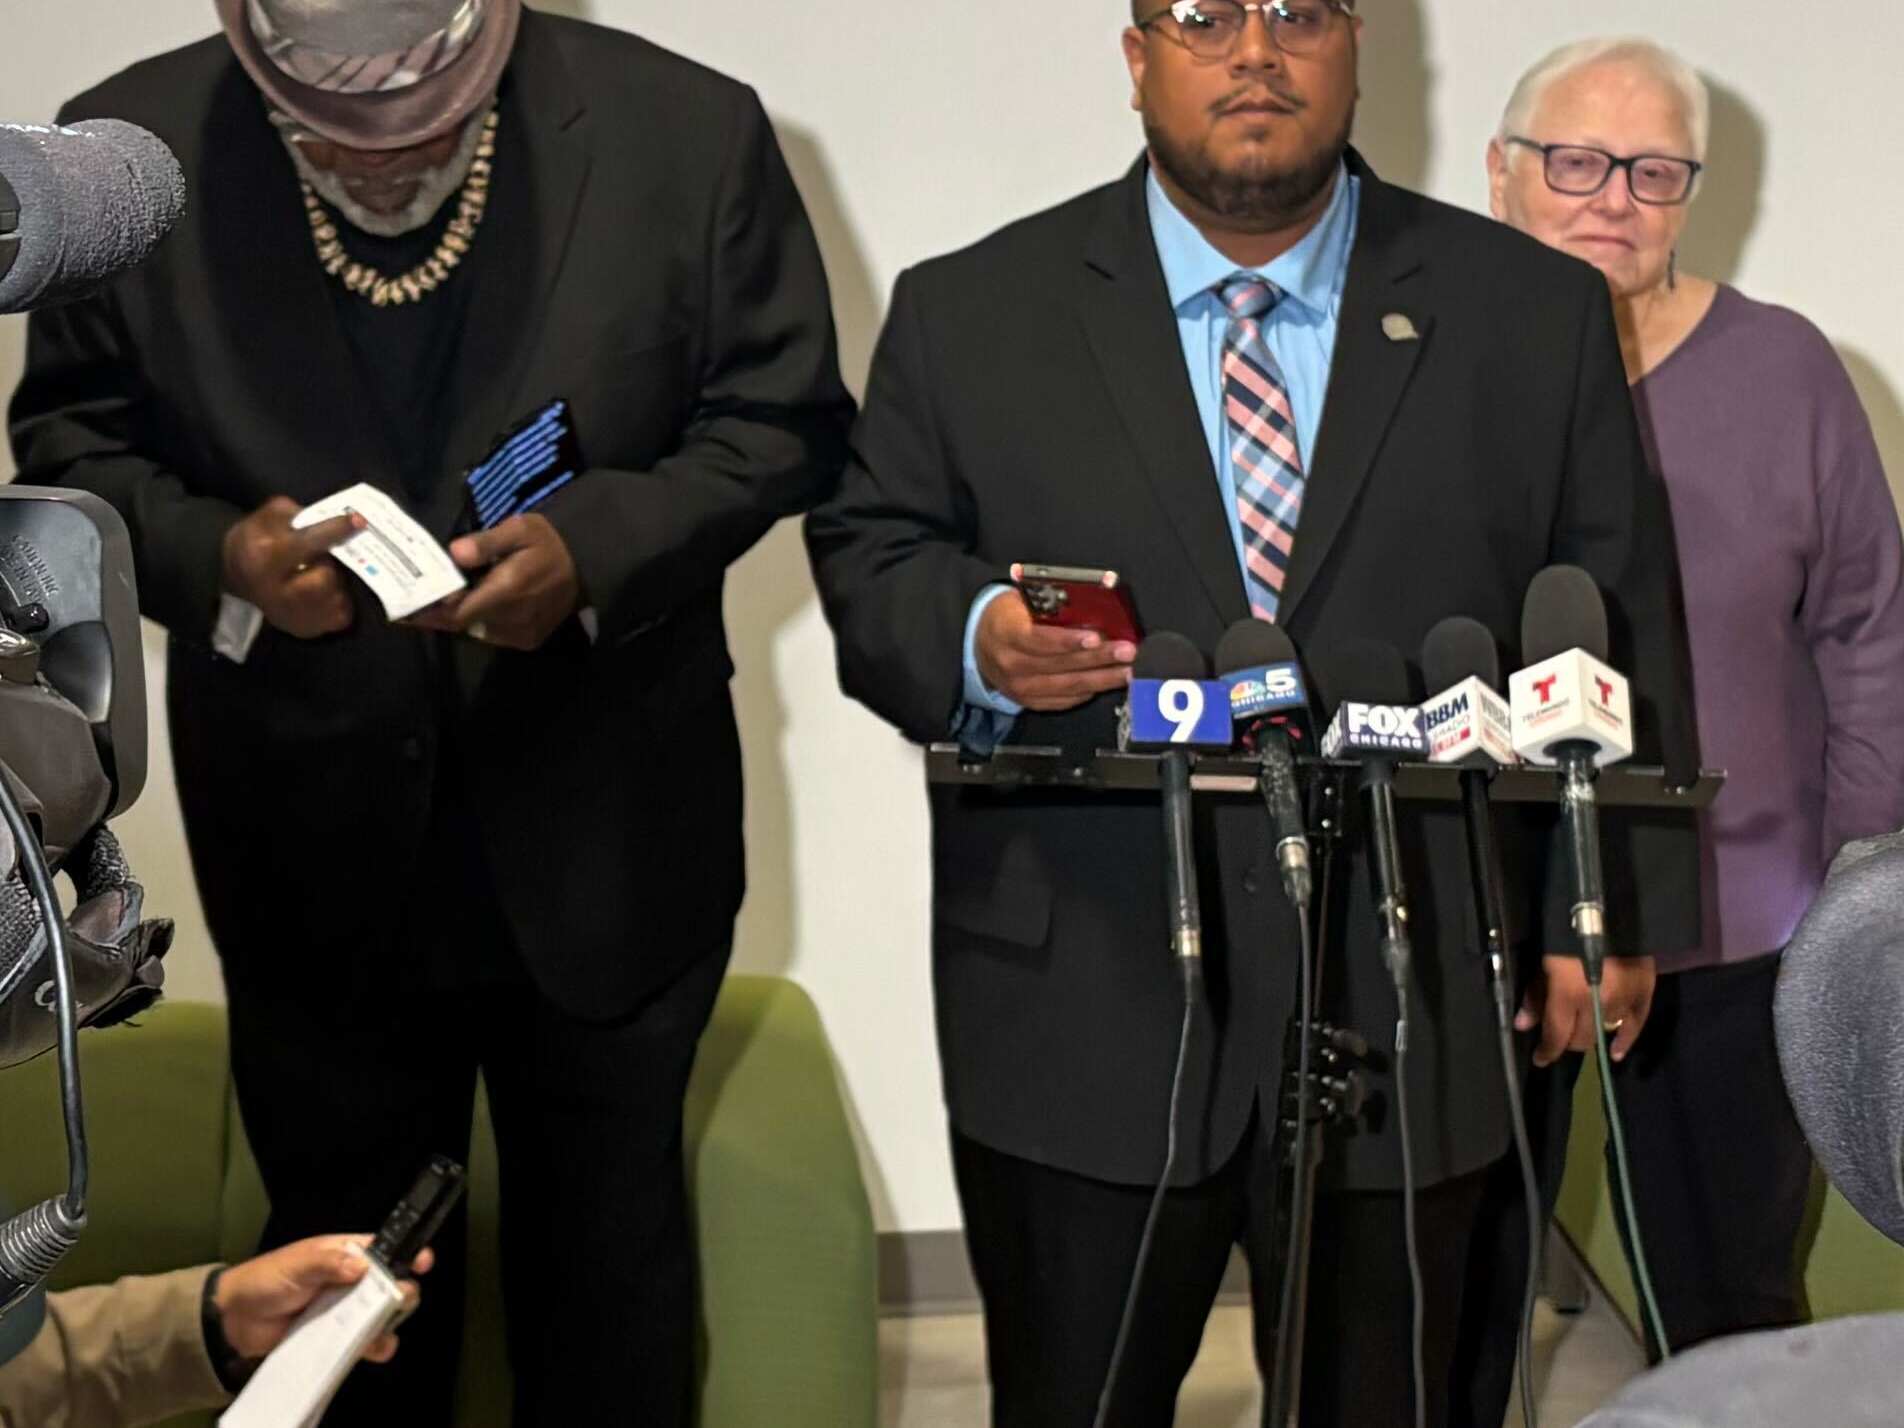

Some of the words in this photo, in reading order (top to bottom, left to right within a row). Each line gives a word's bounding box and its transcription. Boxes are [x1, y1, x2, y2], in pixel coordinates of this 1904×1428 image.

[1265, 667, 1297, 693] 5
[1157, 678, 1205, 744] 9
[1346, 701, 1422, 740] FOX
[1348, 732, 1424, 750] CHICAGO
